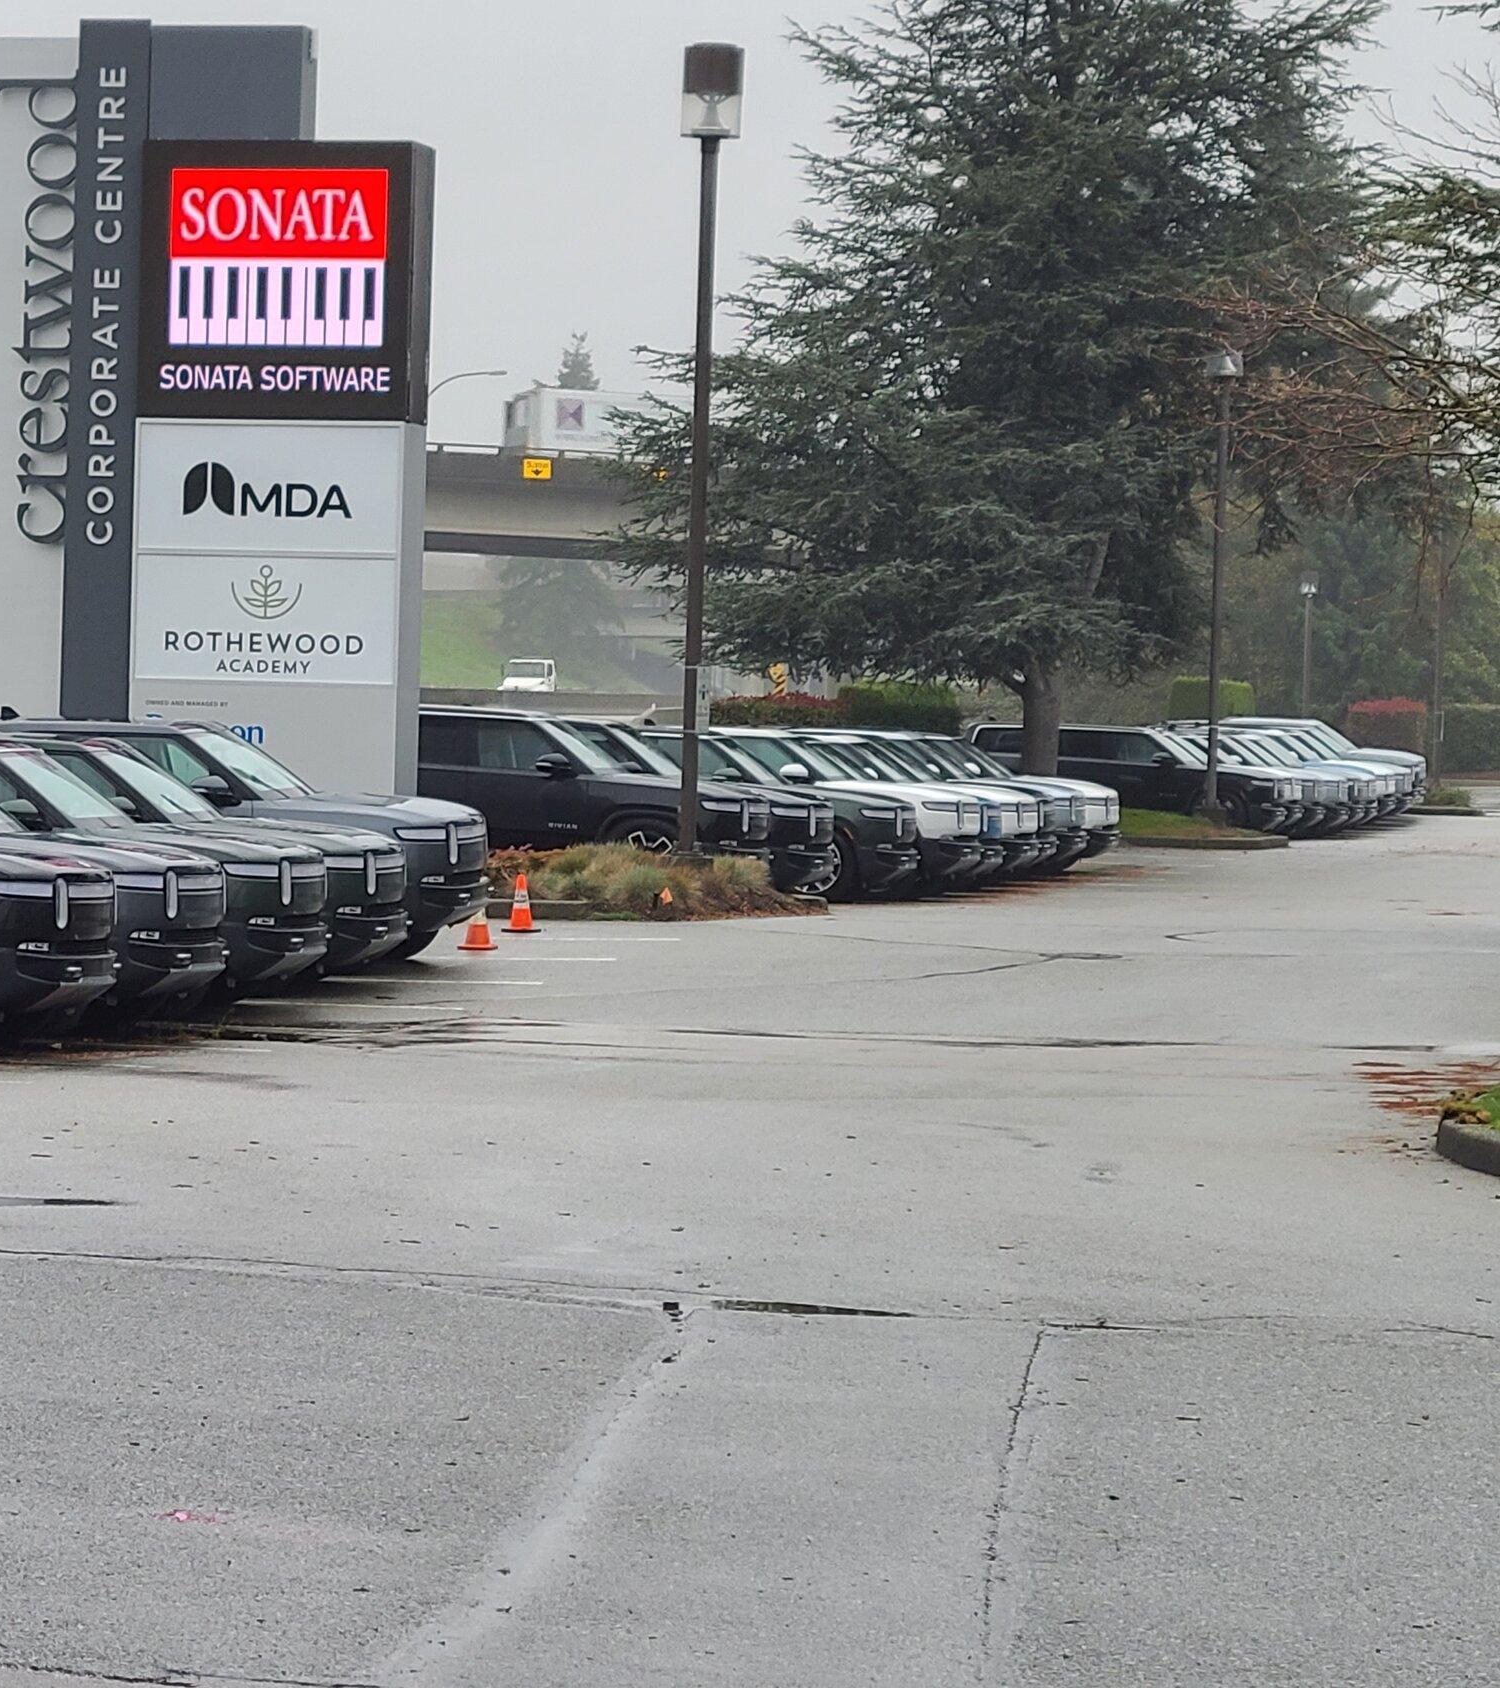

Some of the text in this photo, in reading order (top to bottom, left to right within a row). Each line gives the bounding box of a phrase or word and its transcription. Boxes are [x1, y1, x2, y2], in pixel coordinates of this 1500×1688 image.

[180, 187, 374, 242] SONATA
[86, 67, 127, 545] CORPORATE CENTRE
[160, 364, 391, 393] SONATA SOFTWARE
[241, 482, 353, 519] MDA
[164, 630, 364, 655] ROTHEWOOD
[216, 658, 311, 675] ACADEMY
